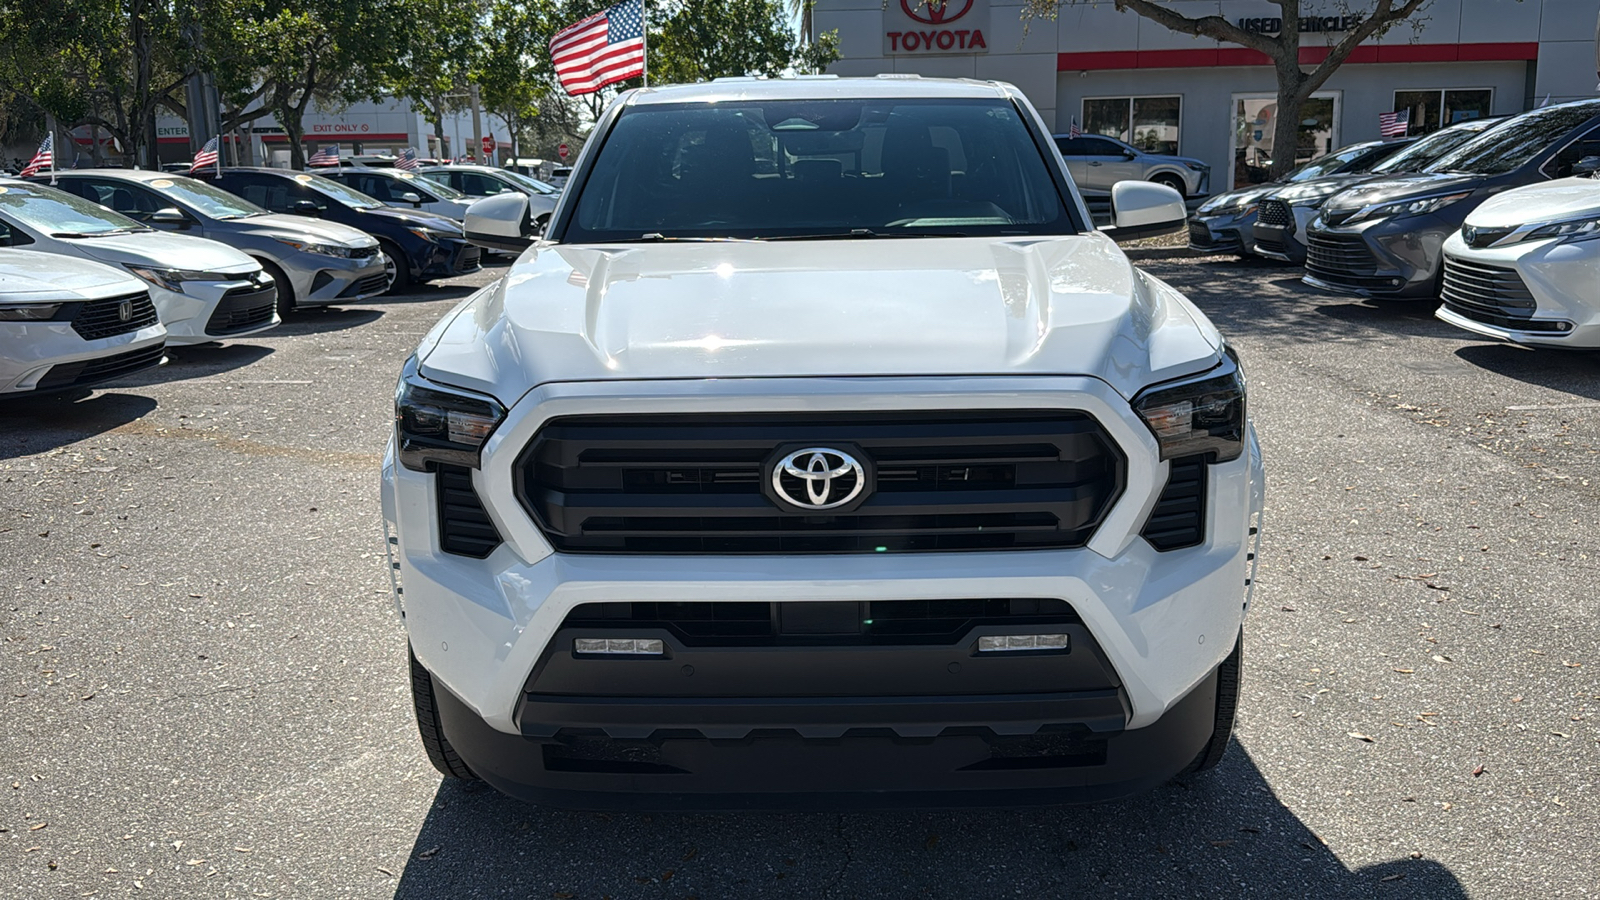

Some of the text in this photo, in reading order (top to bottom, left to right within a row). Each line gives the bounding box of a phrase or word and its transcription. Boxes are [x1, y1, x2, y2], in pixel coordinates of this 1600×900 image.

[1239, 16, 1362, 33] USED EHICLE
[887, 29, 987, 51] TOYOTA
[158, 127, 188, 135] ENTER
[313, 124, 358, 132] EXIT ONLY
